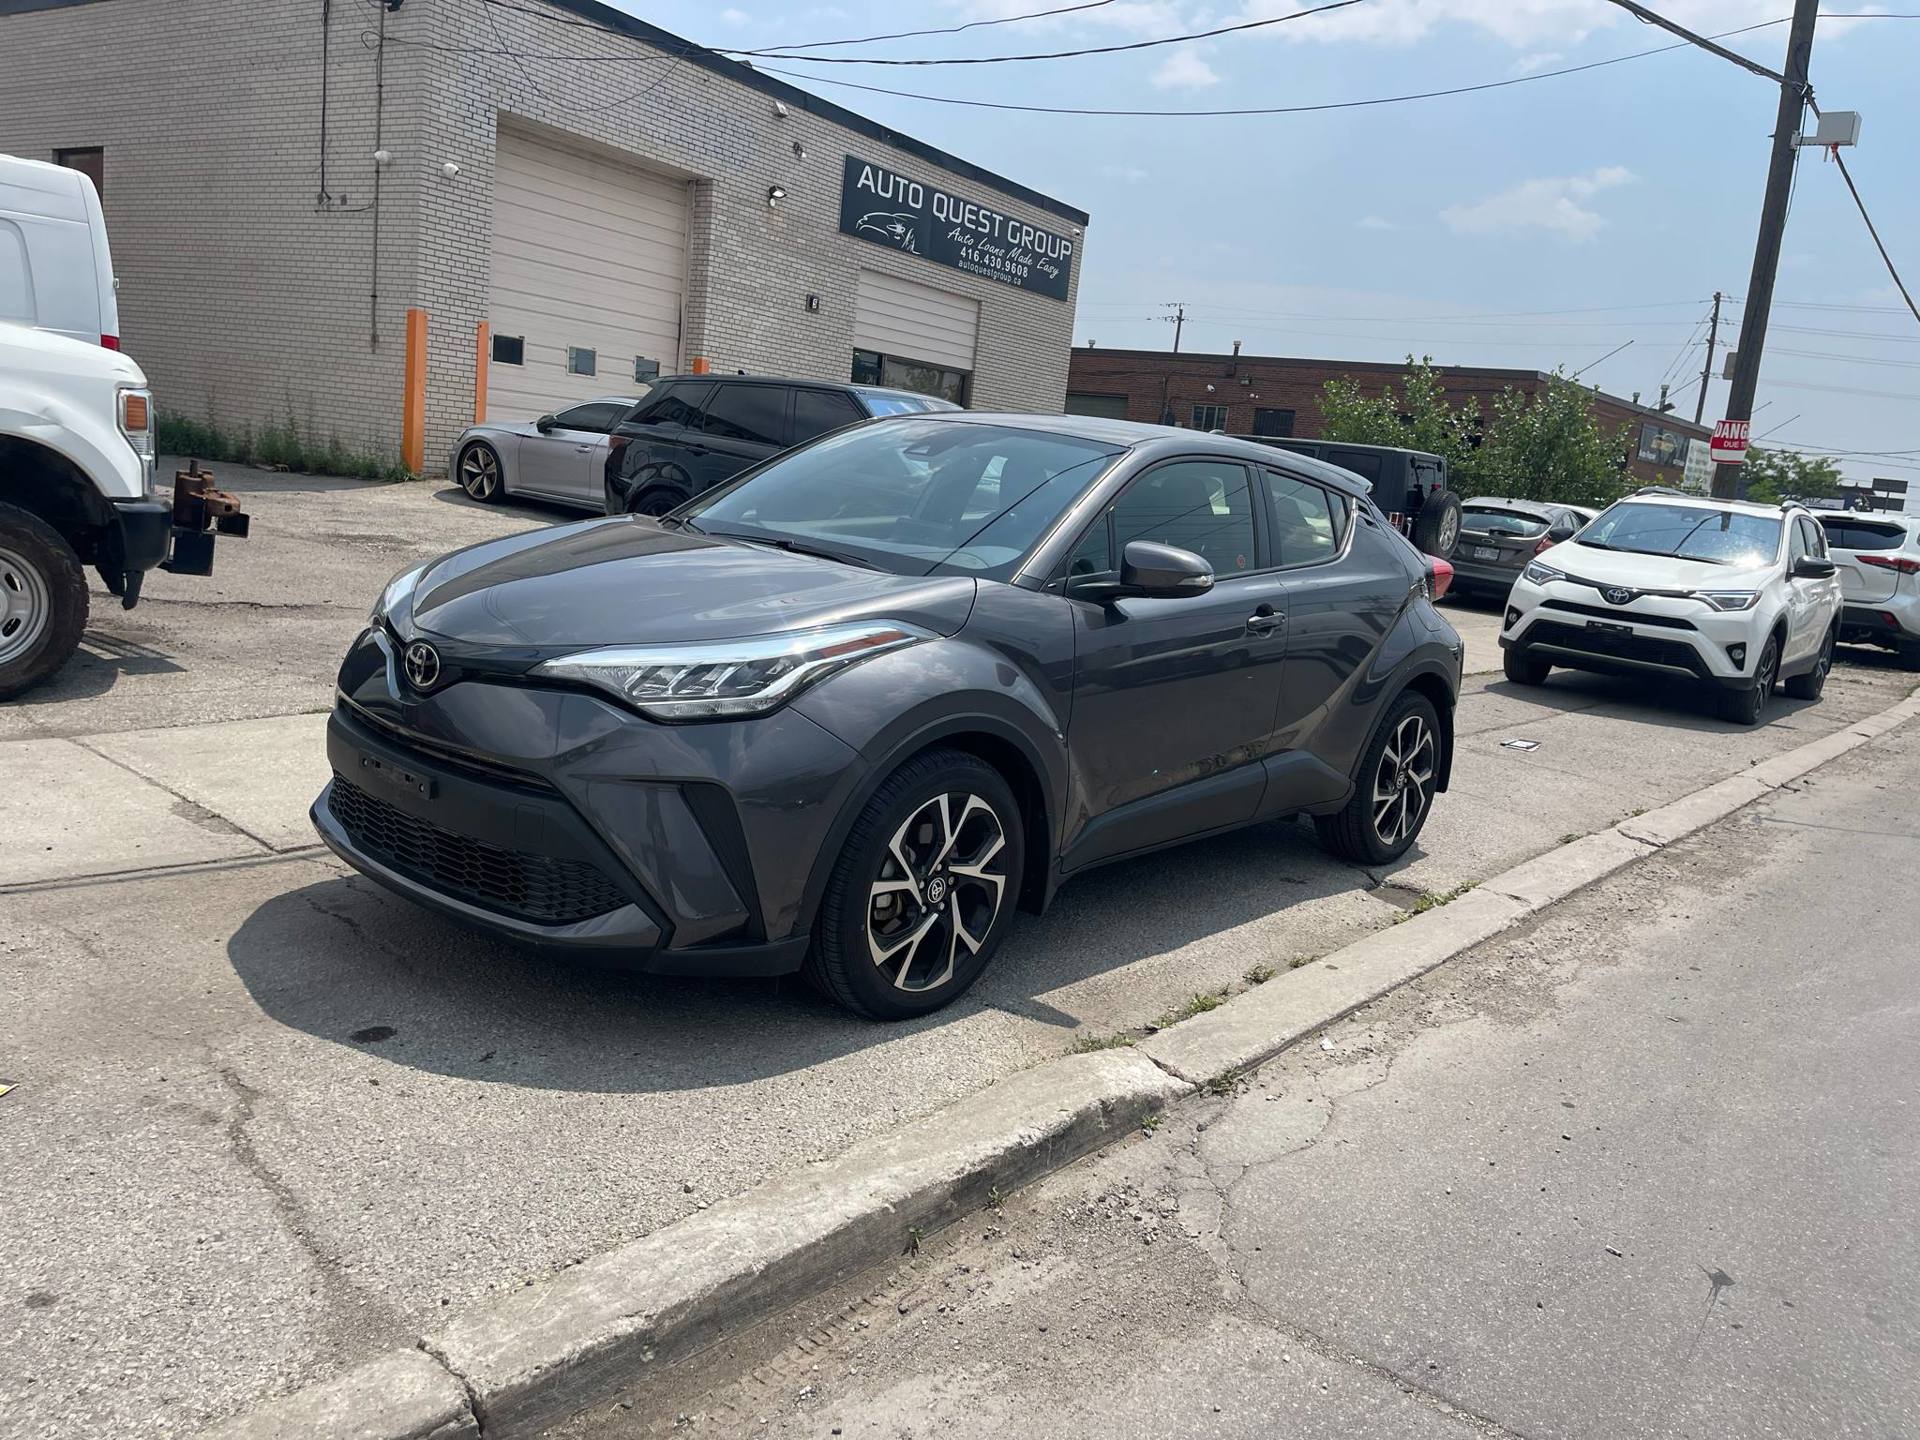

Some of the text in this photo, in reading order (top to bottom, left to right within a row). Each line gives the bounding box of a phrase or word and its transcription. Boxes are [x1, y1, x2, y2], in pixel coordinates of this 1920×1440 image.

[857, 165, 1072, 260] AUTO QUEST GROUP
[947, 227, 1060, 279] Auto Loans Made Easy
[960, 246, 1028, 278] 416.430.9608
[958, 259, 1022, 286] autoquestgroup.ca
[1714, 421, 1749, 440] DANG
